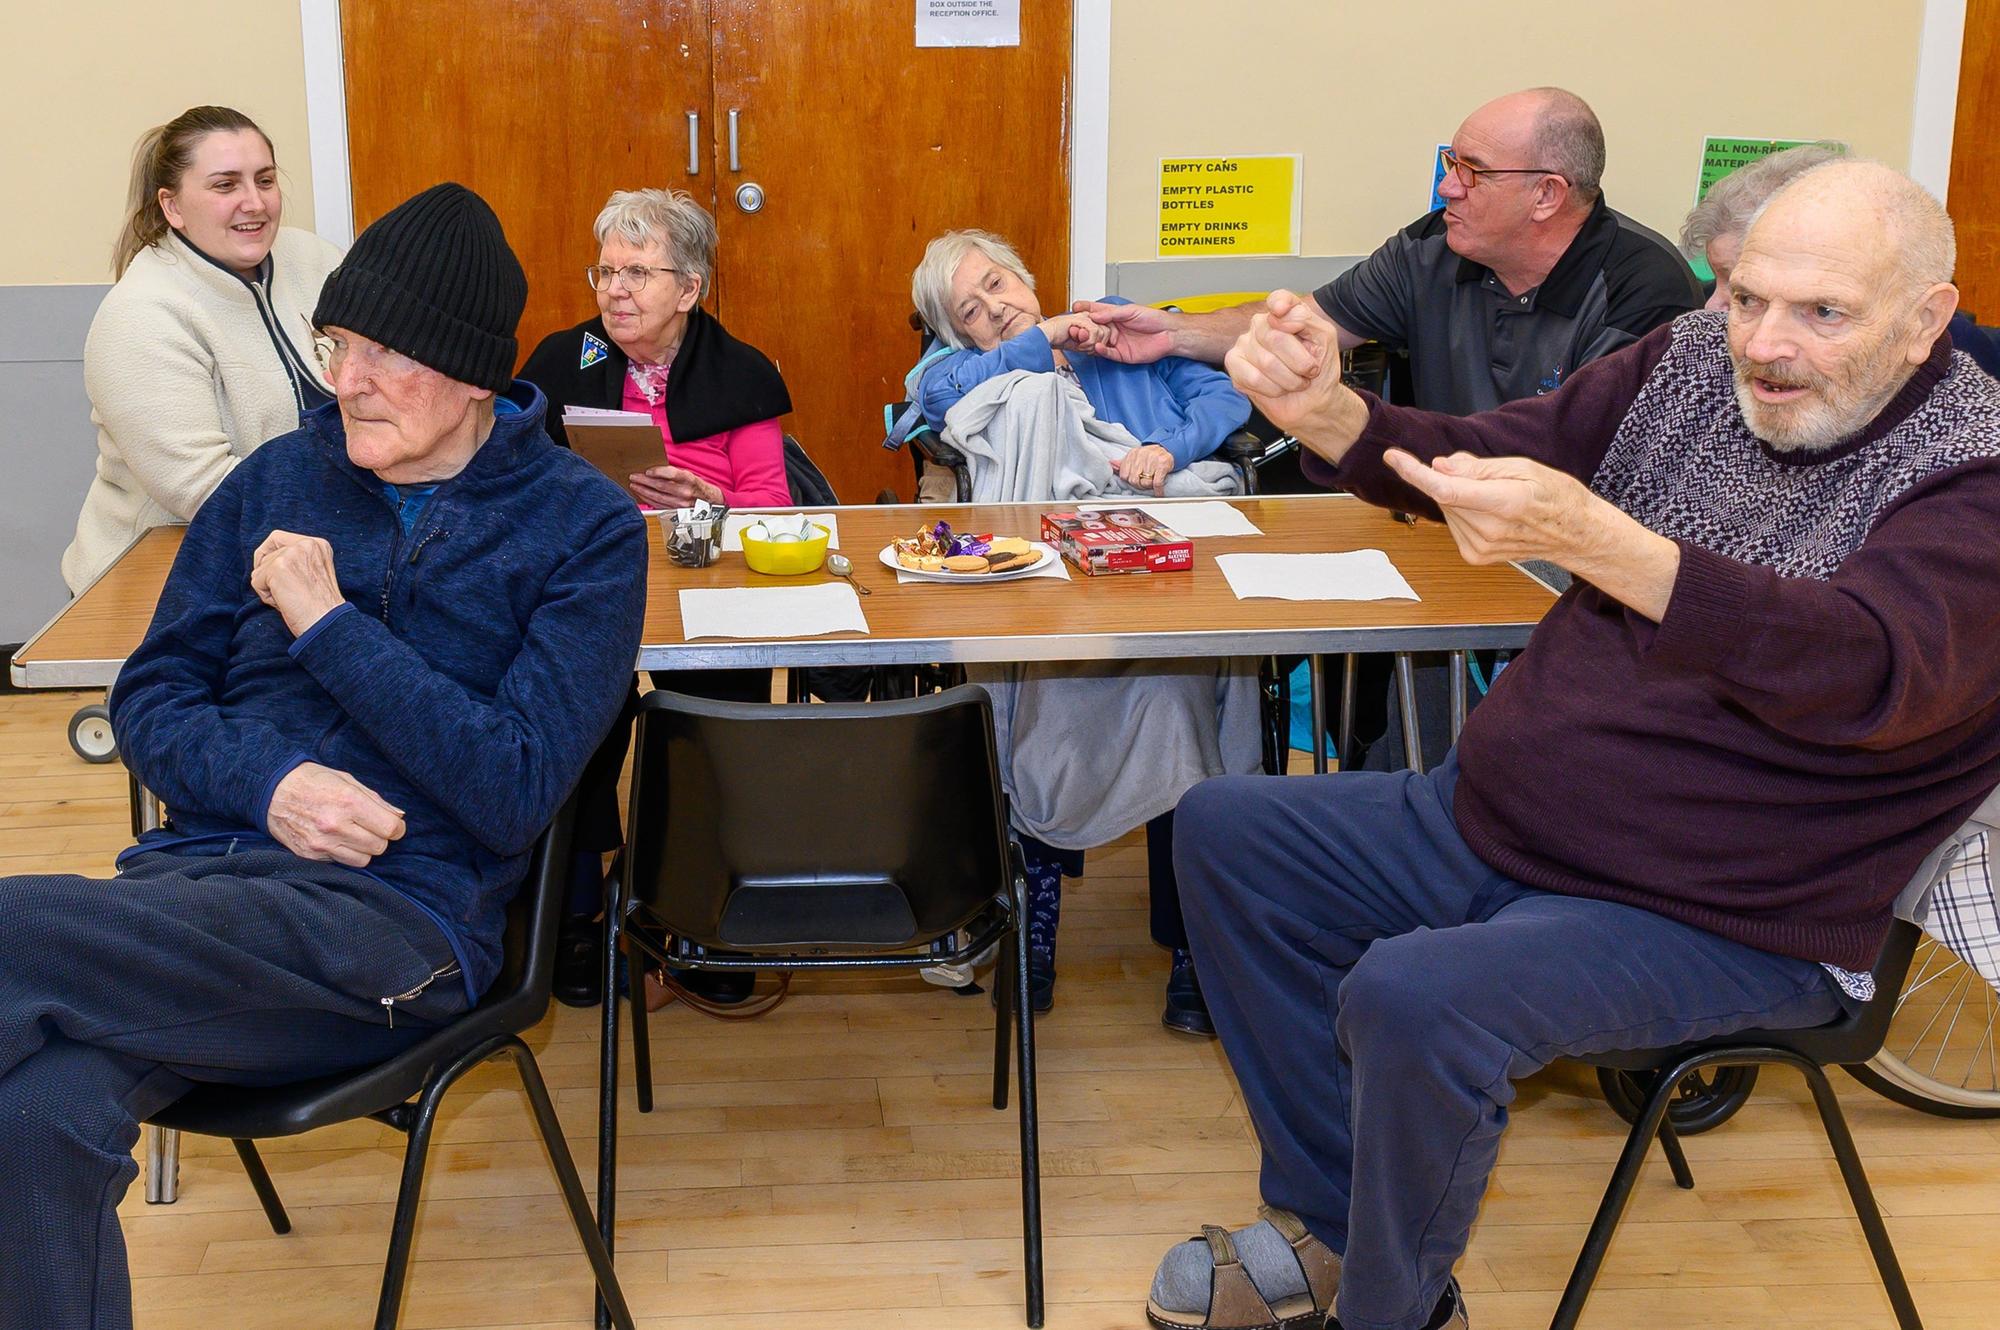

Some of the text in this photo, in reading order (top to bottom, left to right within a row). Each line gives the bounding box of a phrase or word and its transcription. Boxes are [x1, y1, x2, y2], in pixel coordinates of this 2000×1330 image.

[947, 0, 977, 8] OUTSIDE
[971, 9, 999, 17] OFFICE.
[1706, 144, 1729, 153] ALL
[1163, 163, 1238, 173] EMPTY CANS
[1162, 185, 1254, 195] EMPTY PLASTIC
[1162, 200, 1215, 209] BOTTLES
[1161, 222, 1249, 231] EMPTY DRINKS
[1161, 236, 1236, 246] CONTAINERS
